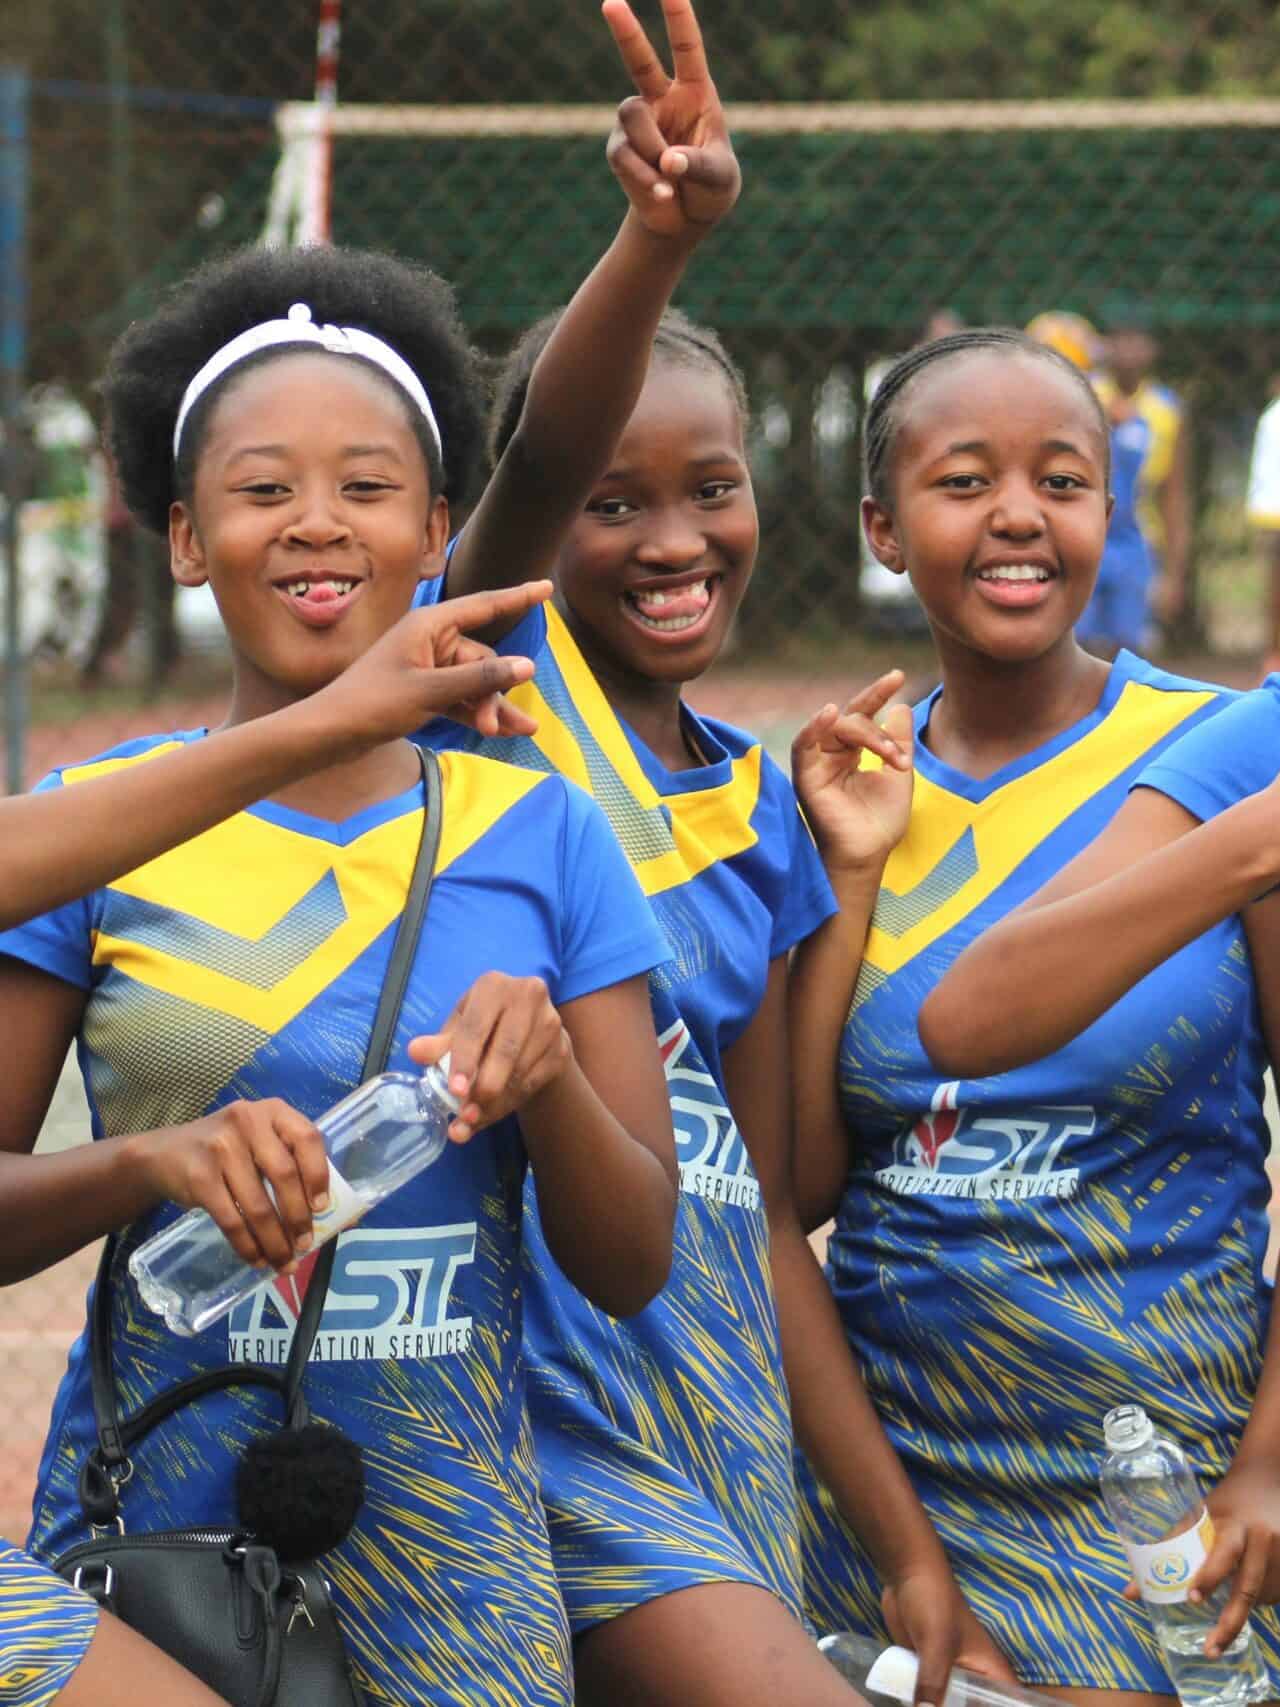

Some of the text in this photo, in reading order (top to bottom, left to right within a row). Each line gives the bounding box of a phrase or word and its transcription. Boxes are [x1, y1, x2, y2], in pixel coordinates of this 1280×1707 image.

[694, 1172, 758, 1210] SERVICE
[880, 1172, 1079, 1200] ERIFICATION SERVICES
[229, 1327, 473, 1363] VERIFATION SERVICES
